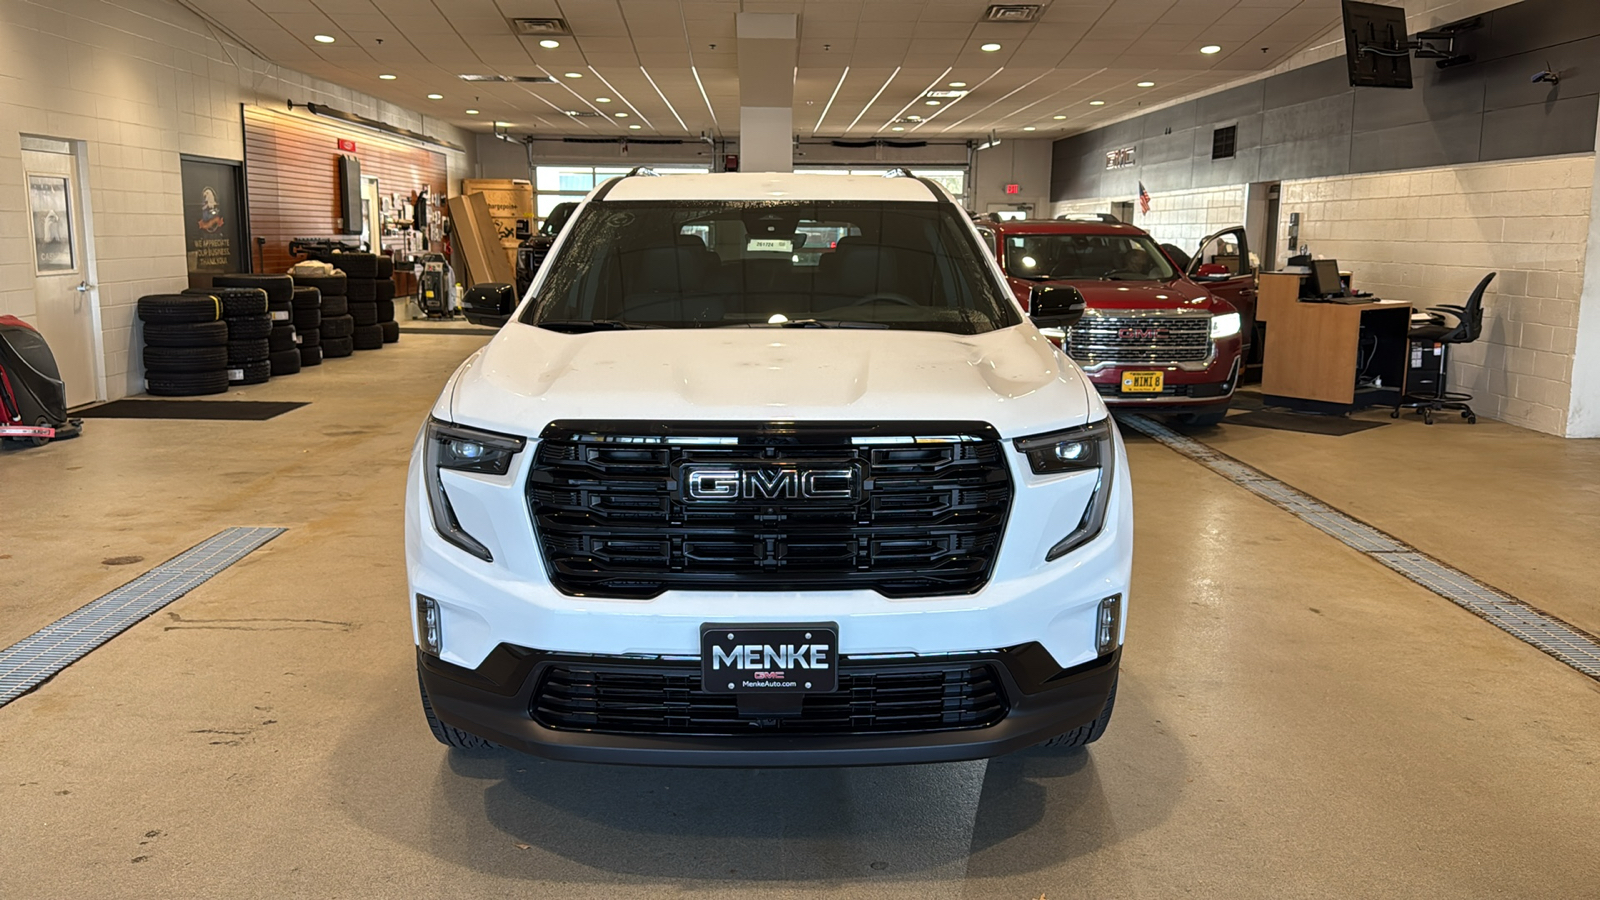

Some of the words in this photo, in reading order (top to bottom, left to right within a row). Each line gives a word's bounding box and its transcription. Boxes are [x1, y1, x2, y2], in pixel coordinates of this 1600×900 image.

[1106, 148, 1136, 169] GMC
[1007, 184, 1018, 194] EXIT
[194, 239, 202, 248] WE
[203, 239, 230, 248] APPRECIATE
[200, 258, 216, 266] THANK
[1118, 328, 1169, 339] GMC
[1155, 376, 1161, 387] 8
[689, 469, 852, 498] GMC
[712, 644, 829, 670] MENKE
[754, 671, 785, 679] GMC
